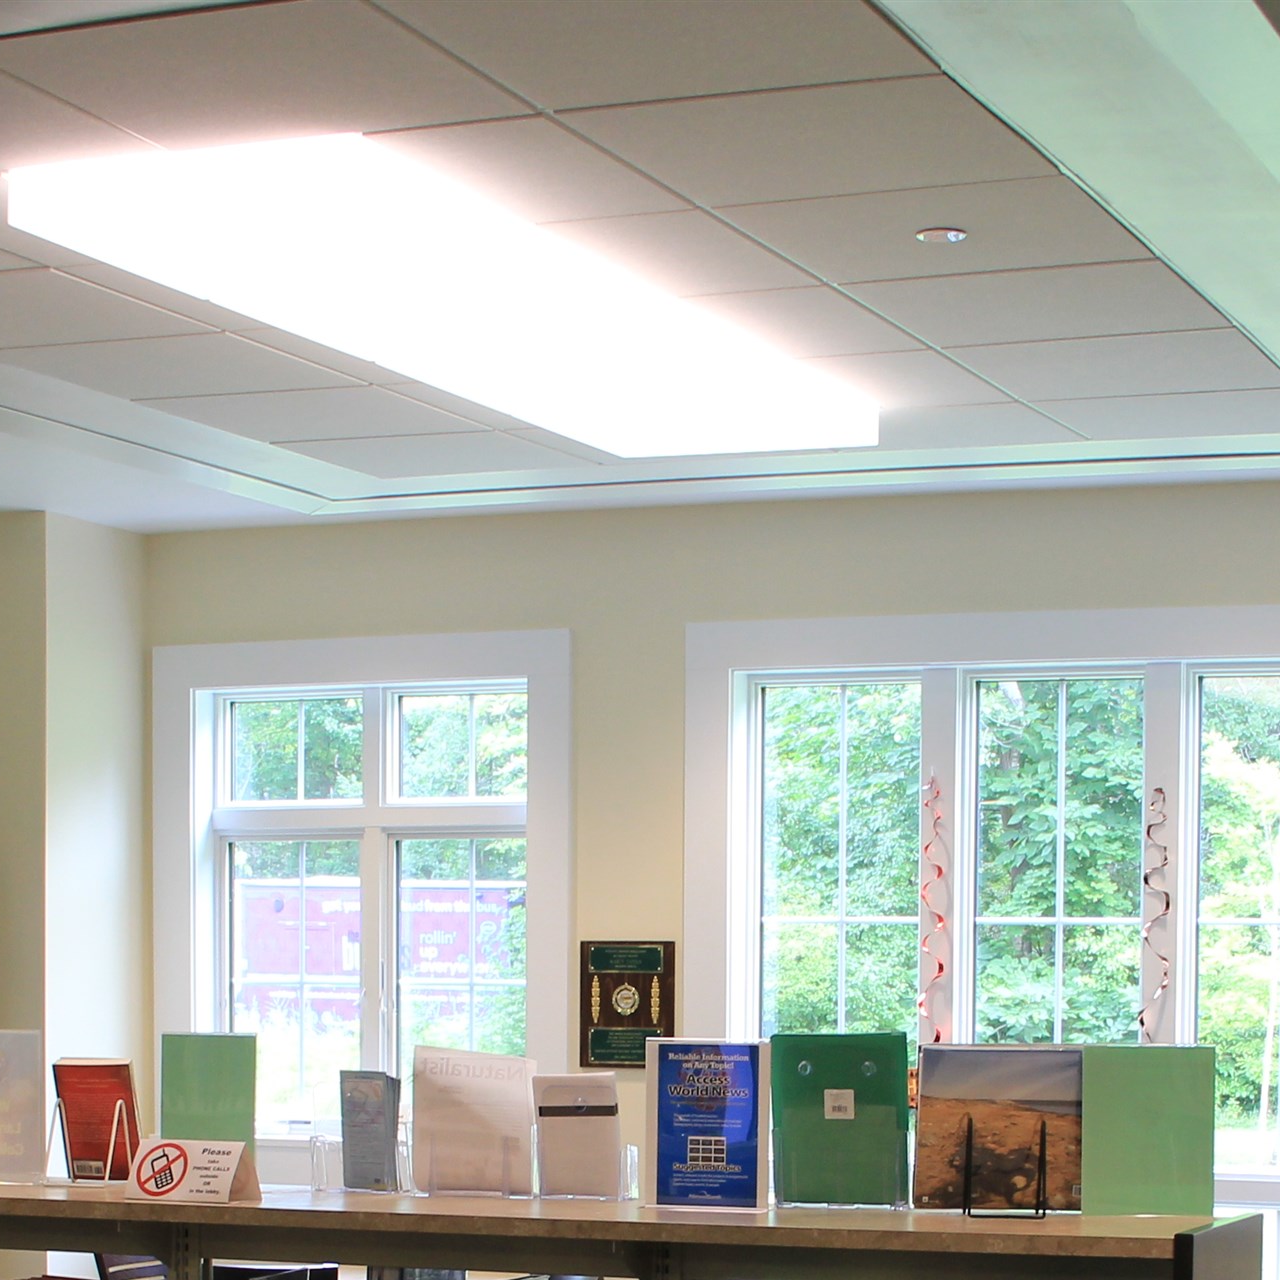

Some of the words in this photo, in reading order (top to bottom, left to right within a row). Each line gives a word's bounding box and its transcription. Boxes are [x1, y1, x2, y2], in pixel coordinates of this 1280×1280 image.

[419, 946, 438, 960] up
[668, 1052, 700, 1060] Reliable
[702, 1052, 749, 1061] Information
[686, 1074, 730, 1085] Access
[668, 1085, 709, 1097] World
[711, 1086, 749, 1097] News
[202, 1148, 232, 1156] Please
